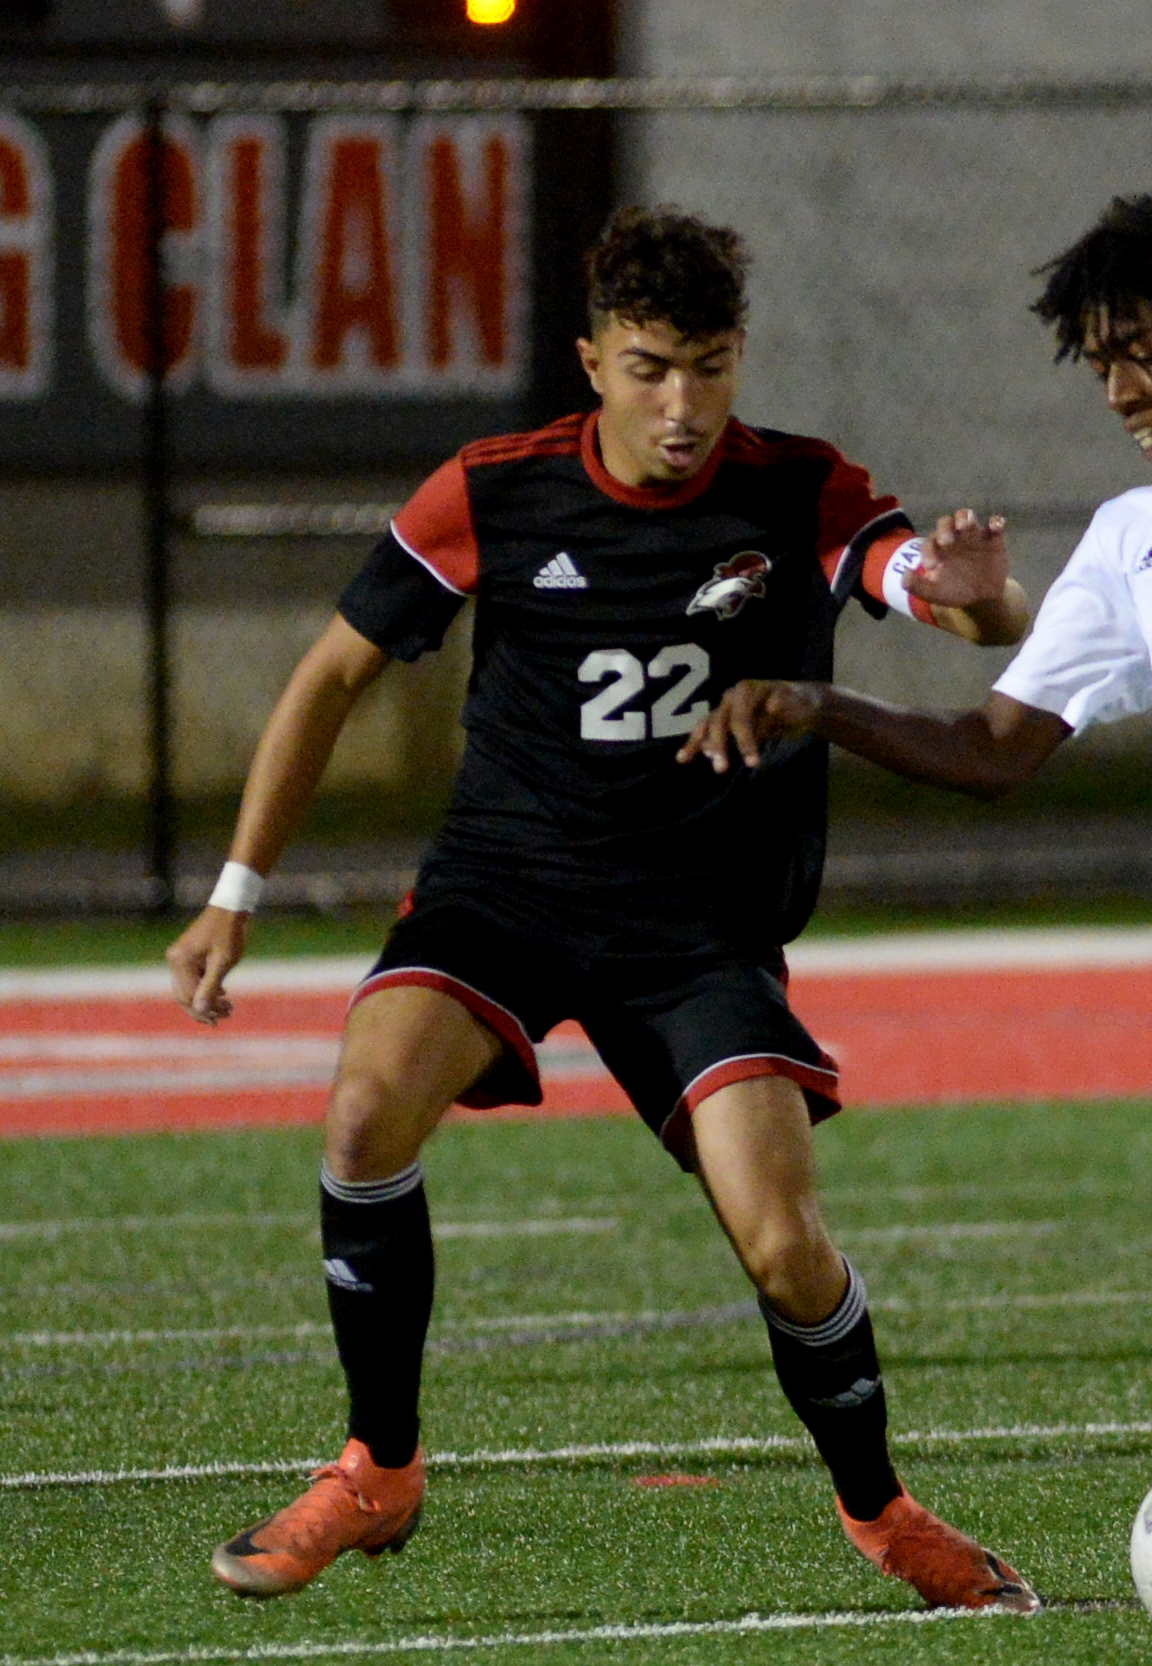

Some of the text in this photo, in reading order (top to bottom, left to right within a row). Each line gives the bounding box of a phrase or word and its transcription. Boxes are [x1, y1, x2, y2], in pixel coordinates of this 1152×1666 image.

[96, 118, 524, 393] CLAN
[532, 575, 588, 589] adidas
[577, 643, 711, 741] 22
